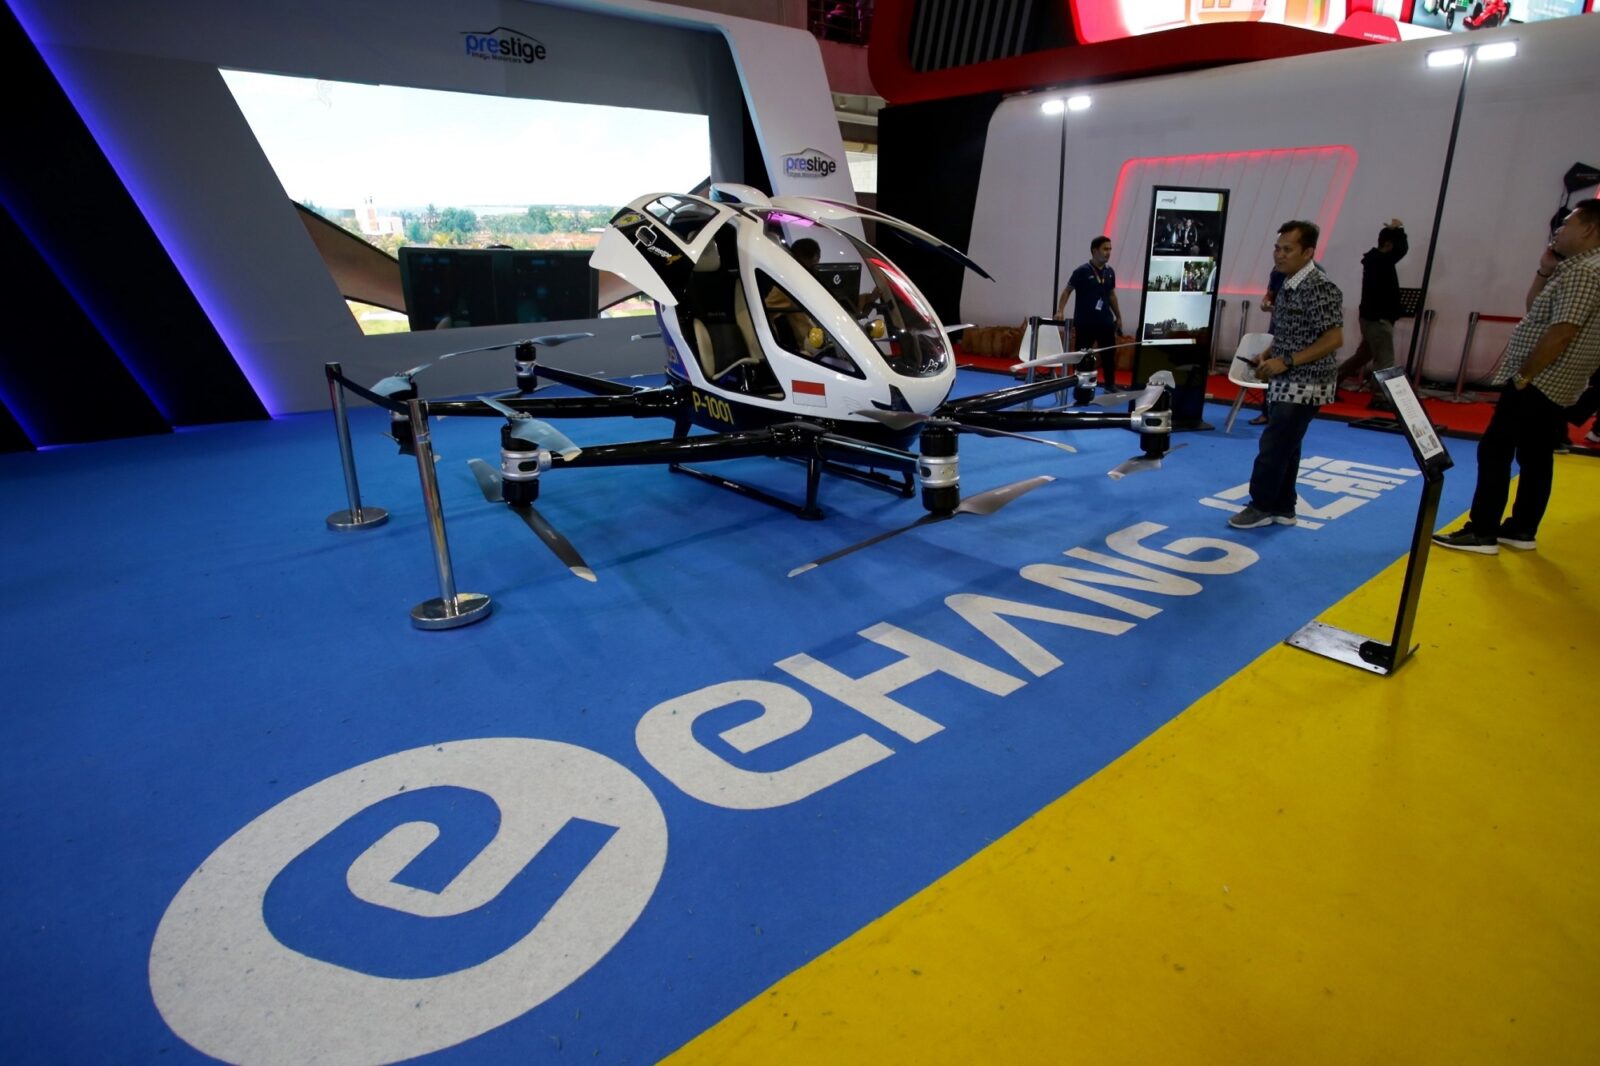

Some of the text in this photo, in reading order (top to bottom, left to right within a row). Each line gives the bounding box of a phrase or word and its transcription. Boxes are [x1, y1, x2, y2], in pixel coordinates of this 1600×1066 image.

[466, 35, 546, 63] prestige
[786, 157, 836, 176] prestige
[692, 390, 734, 425] P-1001
